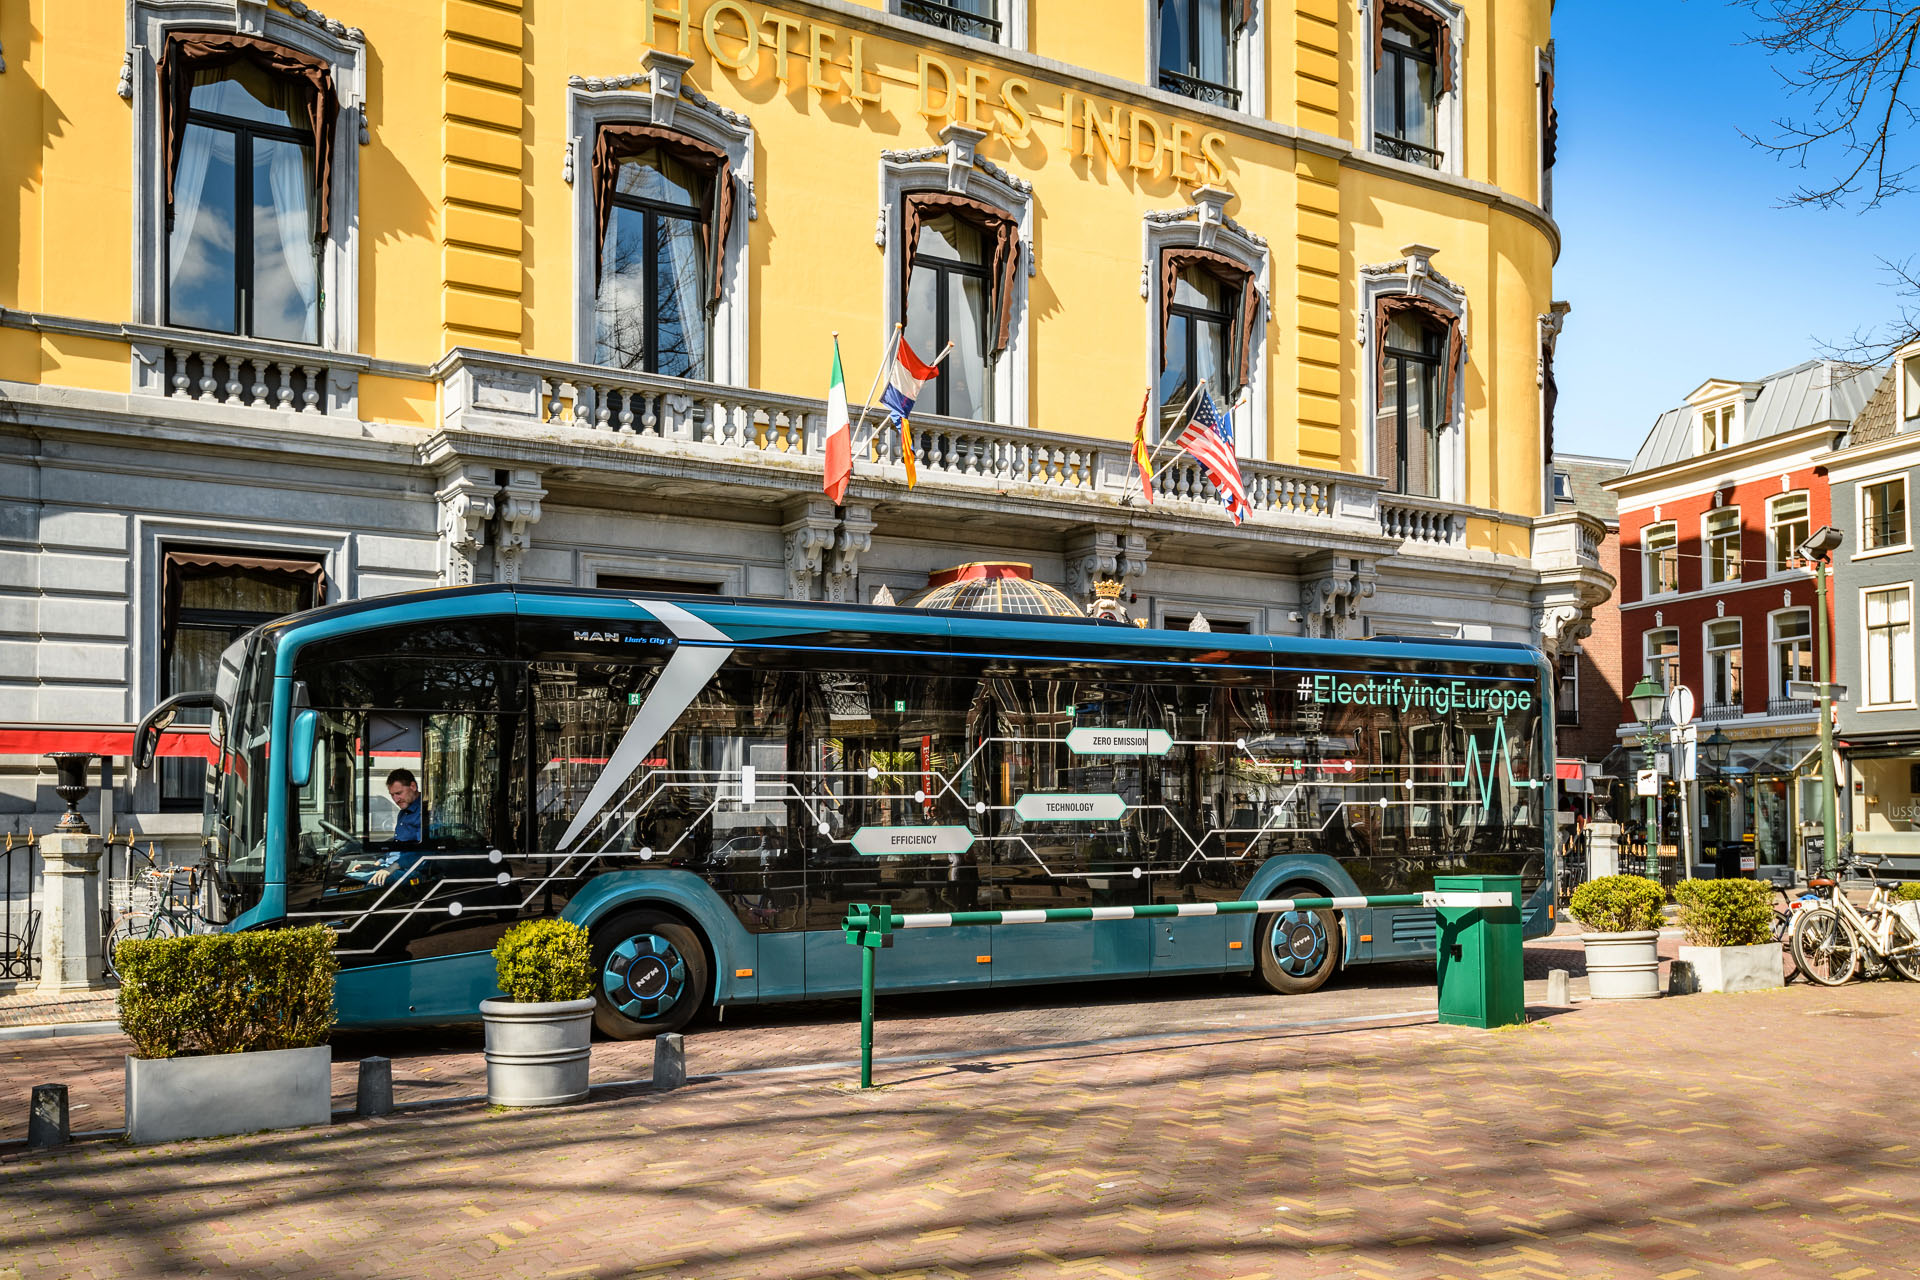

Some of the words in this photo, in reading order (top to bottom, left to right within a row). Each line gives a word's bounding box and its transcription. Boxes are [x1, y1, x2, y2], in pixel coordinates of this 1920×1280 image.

[642, 0, 881, 103] HOTEL
[917, 53, 1032, 140] DES
[1062, 91, 1228, 185] INDES
[573, 631, 620, 643] MAN
[624, 636, 647, 644] Lion's
[649, 637, 665, 645] City
[1297, 675, 1531, 715] #ElectrifyingEurope
[1092, 736, 1111, 746] ZERO
[1112, 736, 1148, 746] EMISSION
[1046, 803, 1094, 812] TECHNOLOGY
[891, 835, 937, 845] EFFICIENCY
[636, 967, 659, 988] MAN
